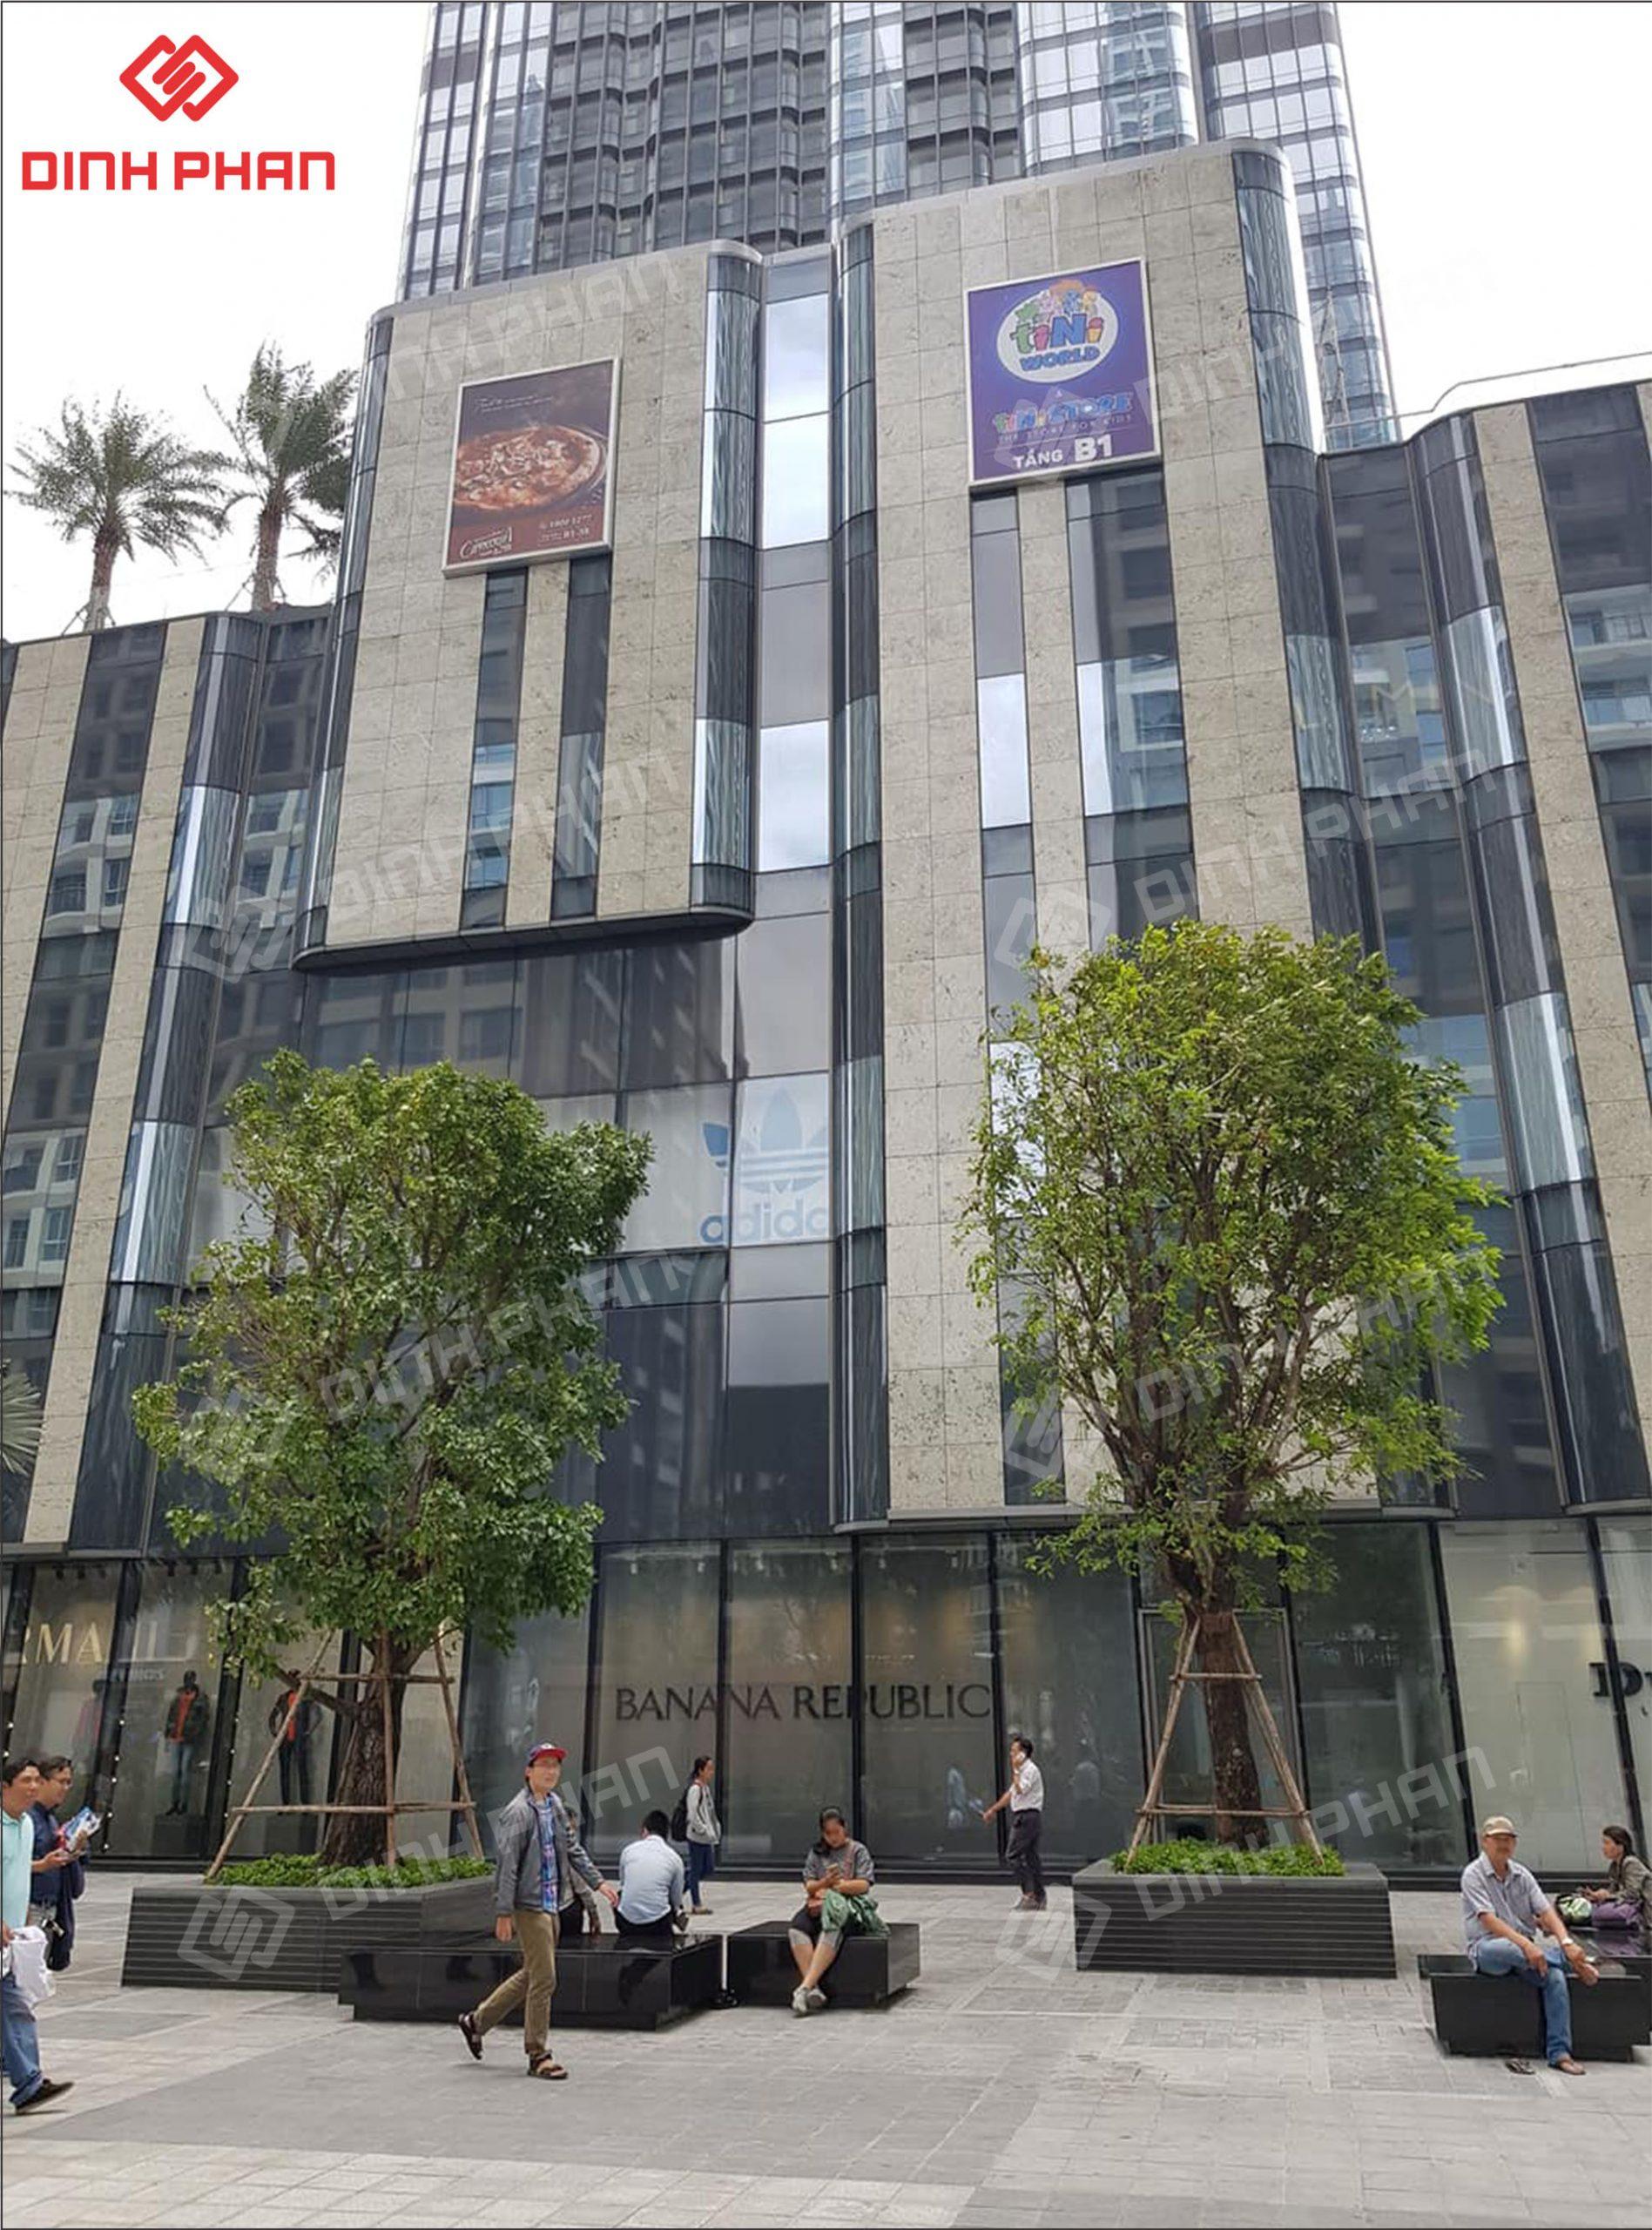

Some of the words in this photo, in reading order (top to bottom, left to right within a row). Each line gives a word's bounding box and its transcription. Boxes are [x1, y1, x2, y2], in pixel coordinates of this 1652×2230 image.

[1019, 345, 1101, 371] WORLD
[1074, 434, 1112, 462] B1
[699, 1198, 828, 1243] adida
[616, 1686, 782, 1721] BANANA
